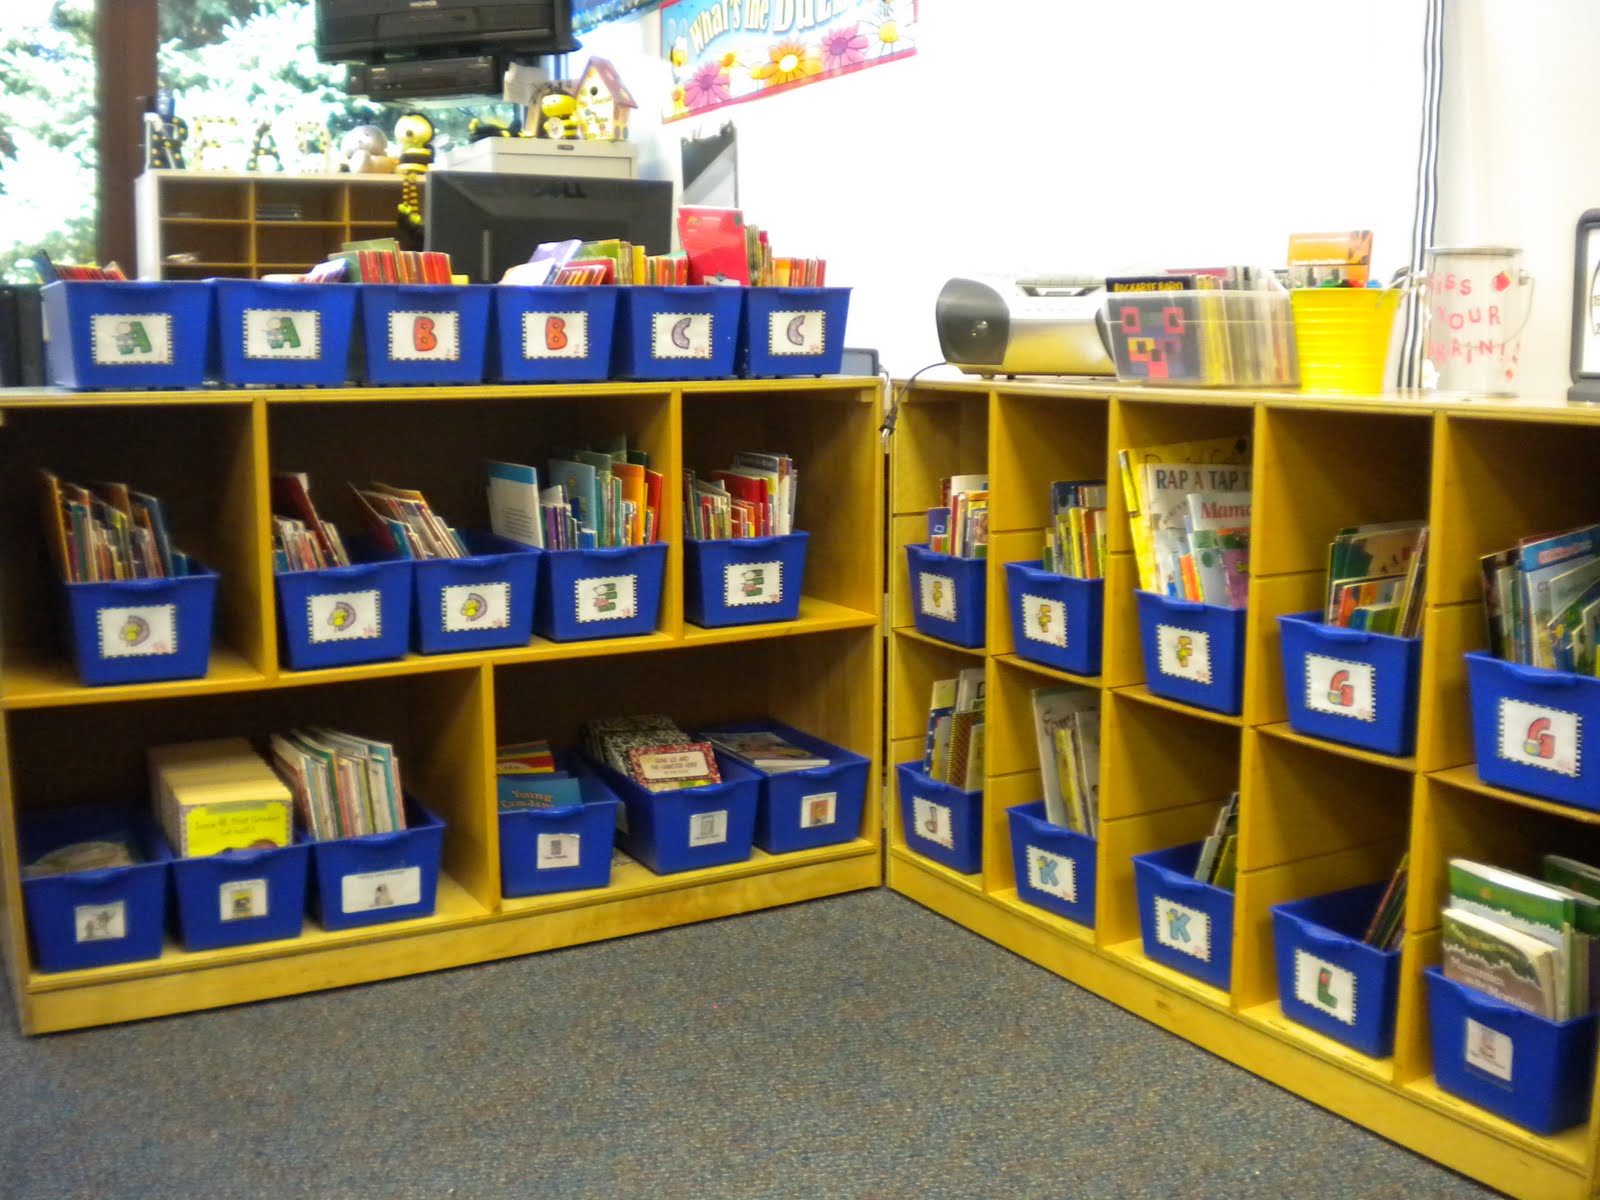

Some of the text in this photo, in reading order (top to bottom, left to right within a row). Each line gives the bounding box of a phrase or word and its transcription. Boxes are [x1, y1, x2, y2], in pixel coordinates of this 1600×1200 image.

[413, 316, 437, 352] B
[545, 316, 568, 350] B
[671, 317, 692, 350] C
[787, 314, 806, 346] C
[1156, 469, 1188, 490] RAP
[1194, 470, 1205, 490] A
[1208, 470, 1239, 491] TAP
[1327, 670, 1354, 707] G
[1523, 717, 1556, 759] G
[1037, 856, 1060, 887] K
[1167, 908, 1191, 943] K
[1317, 967, 1338, 1010] L
